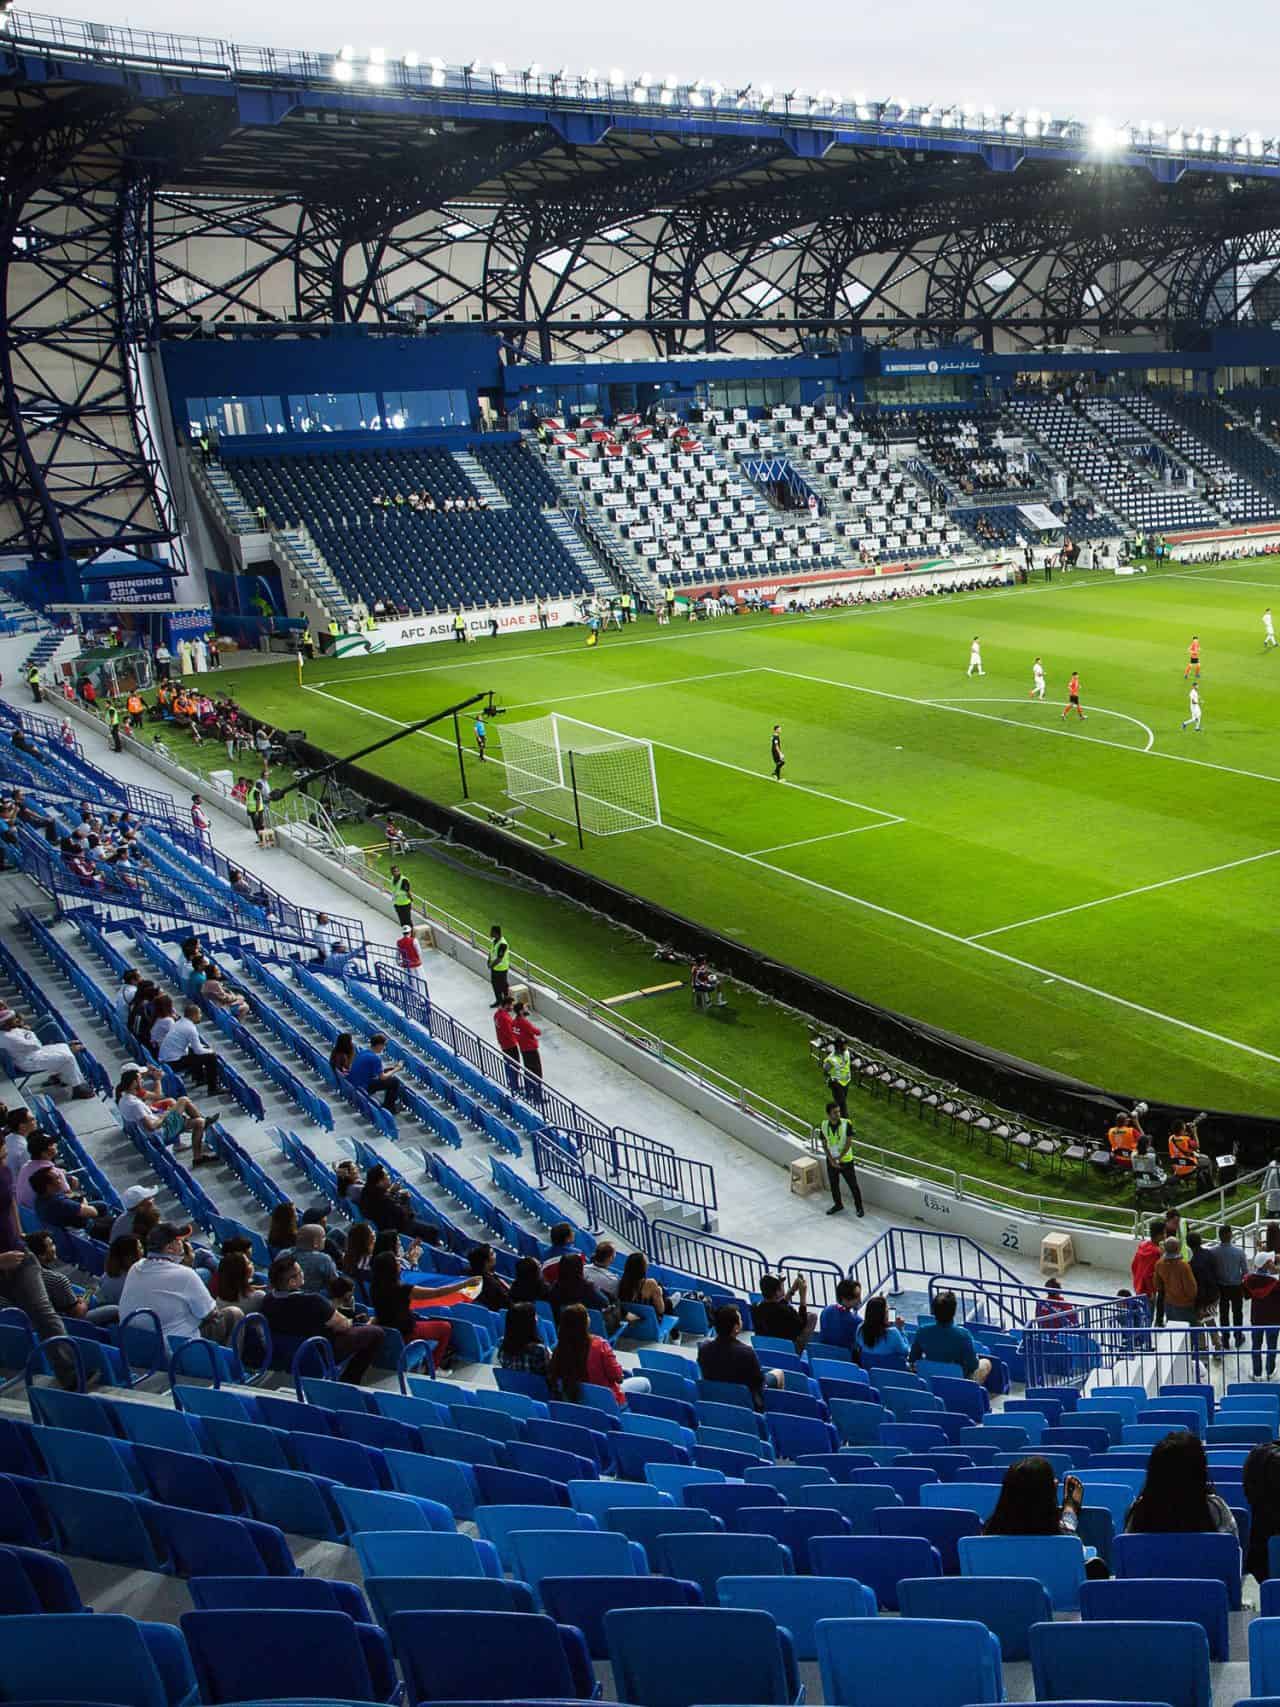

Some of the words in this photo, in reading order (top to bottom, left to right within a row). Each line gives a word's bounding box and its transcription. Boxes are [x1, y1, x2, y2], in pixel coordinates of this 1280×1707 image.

[108, 577, 163, 589] BRINGING
[110, 587, 136, 597] ASIA
[401, 627, 425, 640] AFC
[430, 622, 467, 636] ASIA
[501, 615, 526, 628] UAE
[529, 611, 559, 624] 219
[1001, 1232, 1020, 1250] 22
